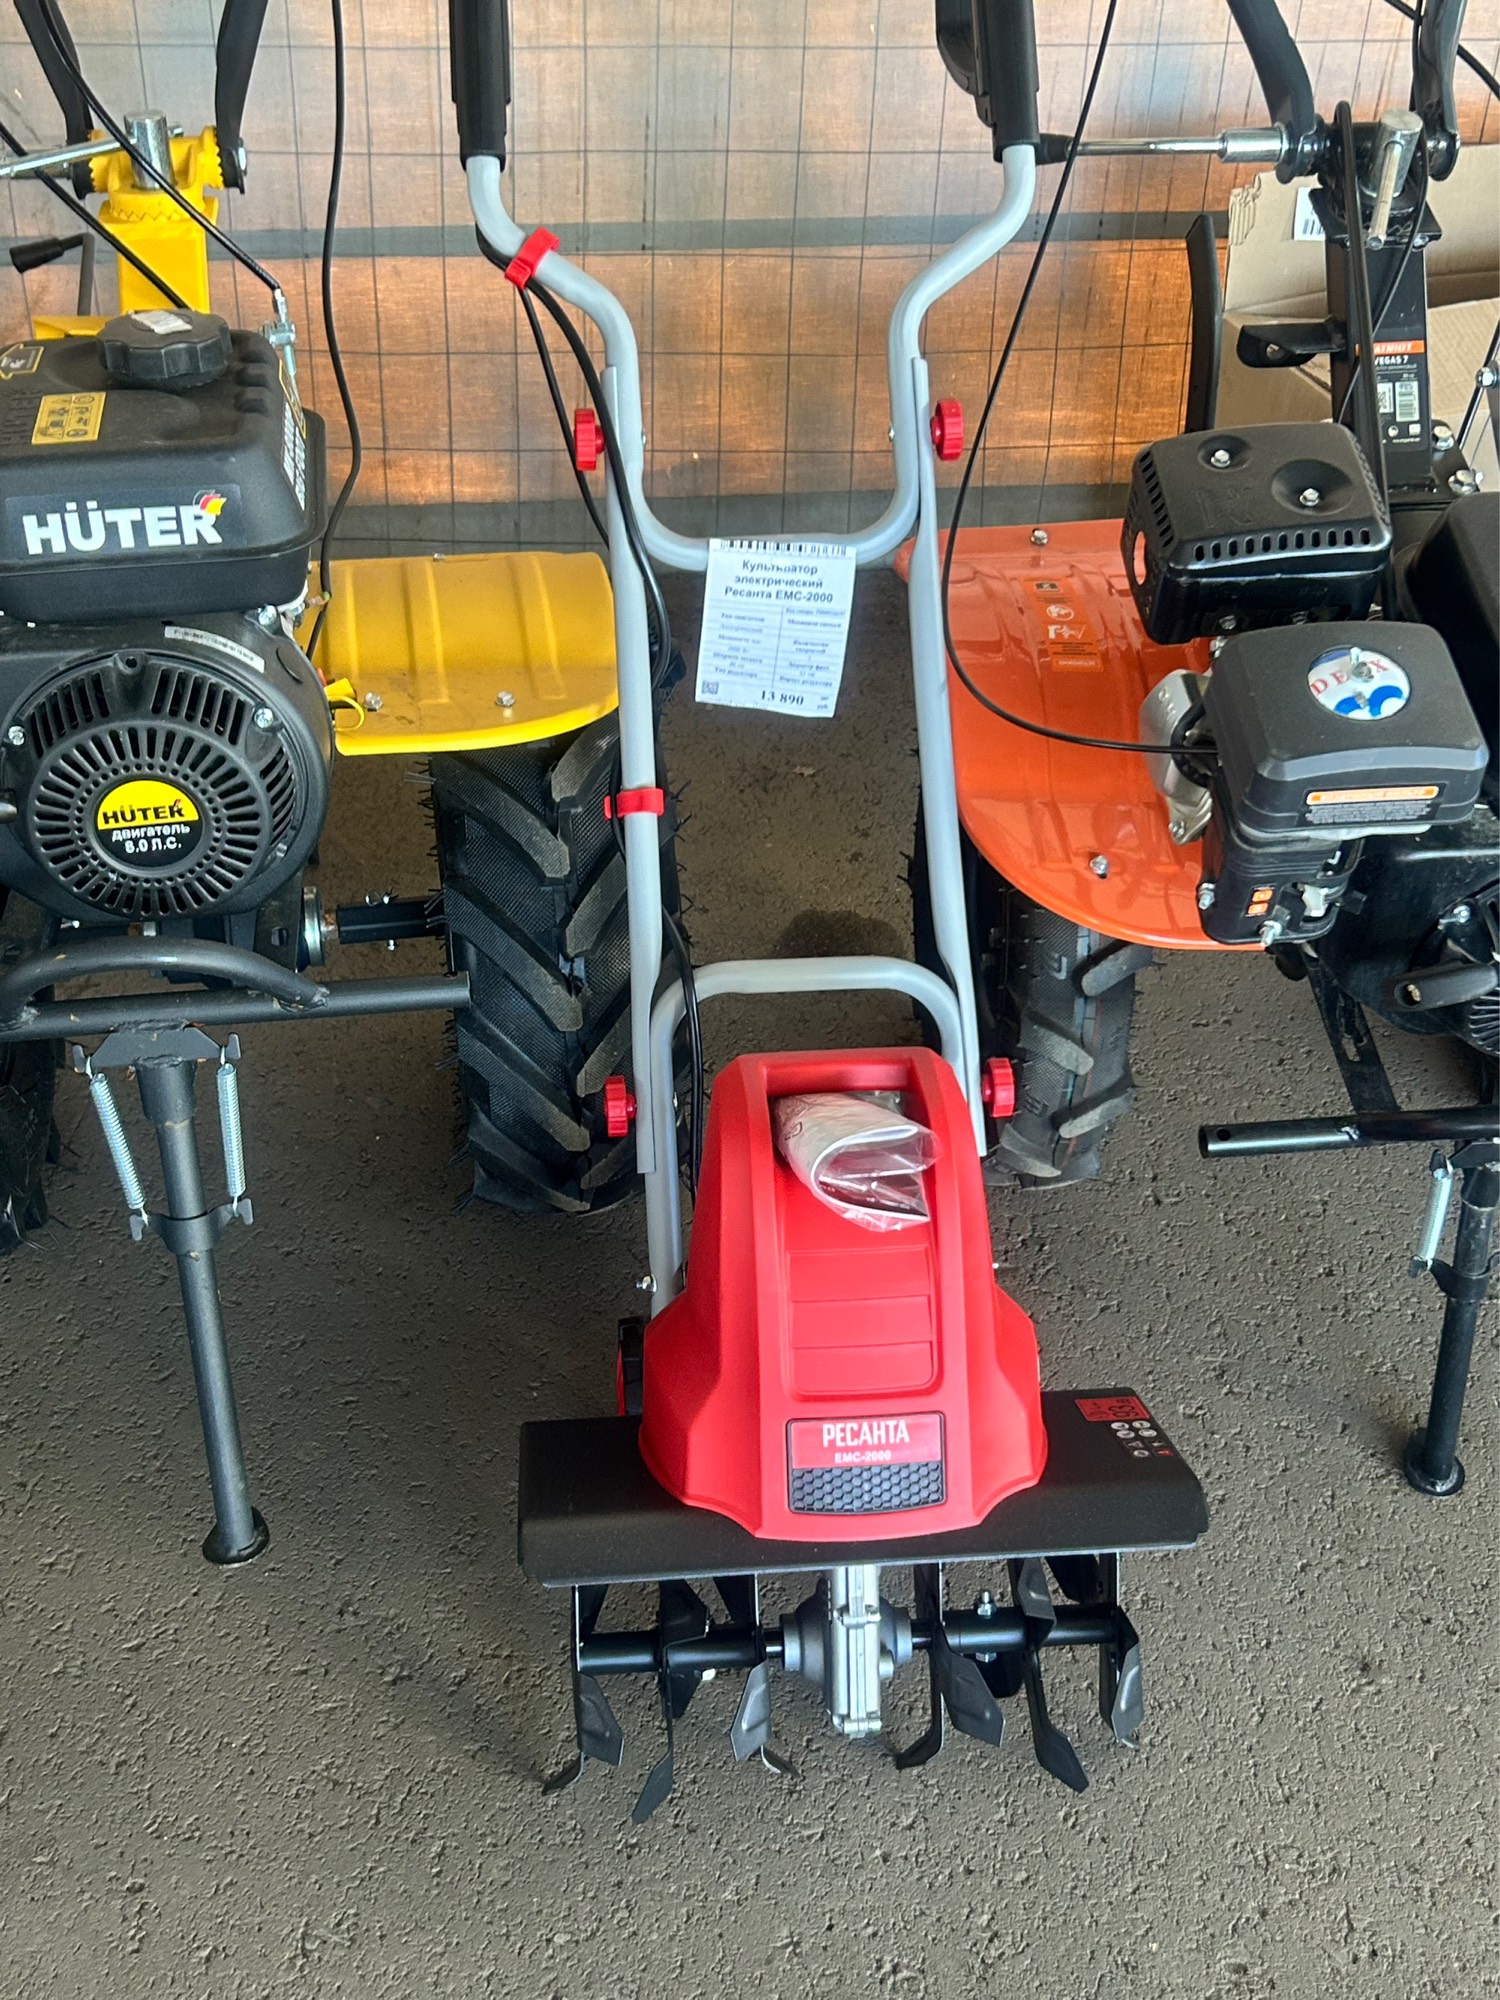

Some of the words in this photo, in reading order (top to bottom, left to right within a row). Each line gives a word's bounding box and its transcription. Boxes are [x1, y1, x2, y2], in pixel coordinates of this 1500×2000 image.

[1373, 343, 1414, 354] ATRIOT
[22, 500, 223, 555] HÜTER
[742, 560, 818, 577] Культиватор
[734, 575, 823, 590] электрический
[724, 586, 772, 600] Ресанта
[761, 690, 776, 701] 13
[780, 693, 804, 706] 890
[102, 804, 185, 825] HÜTER
[822, 1419, 910, 1448] РЕСАНТА
